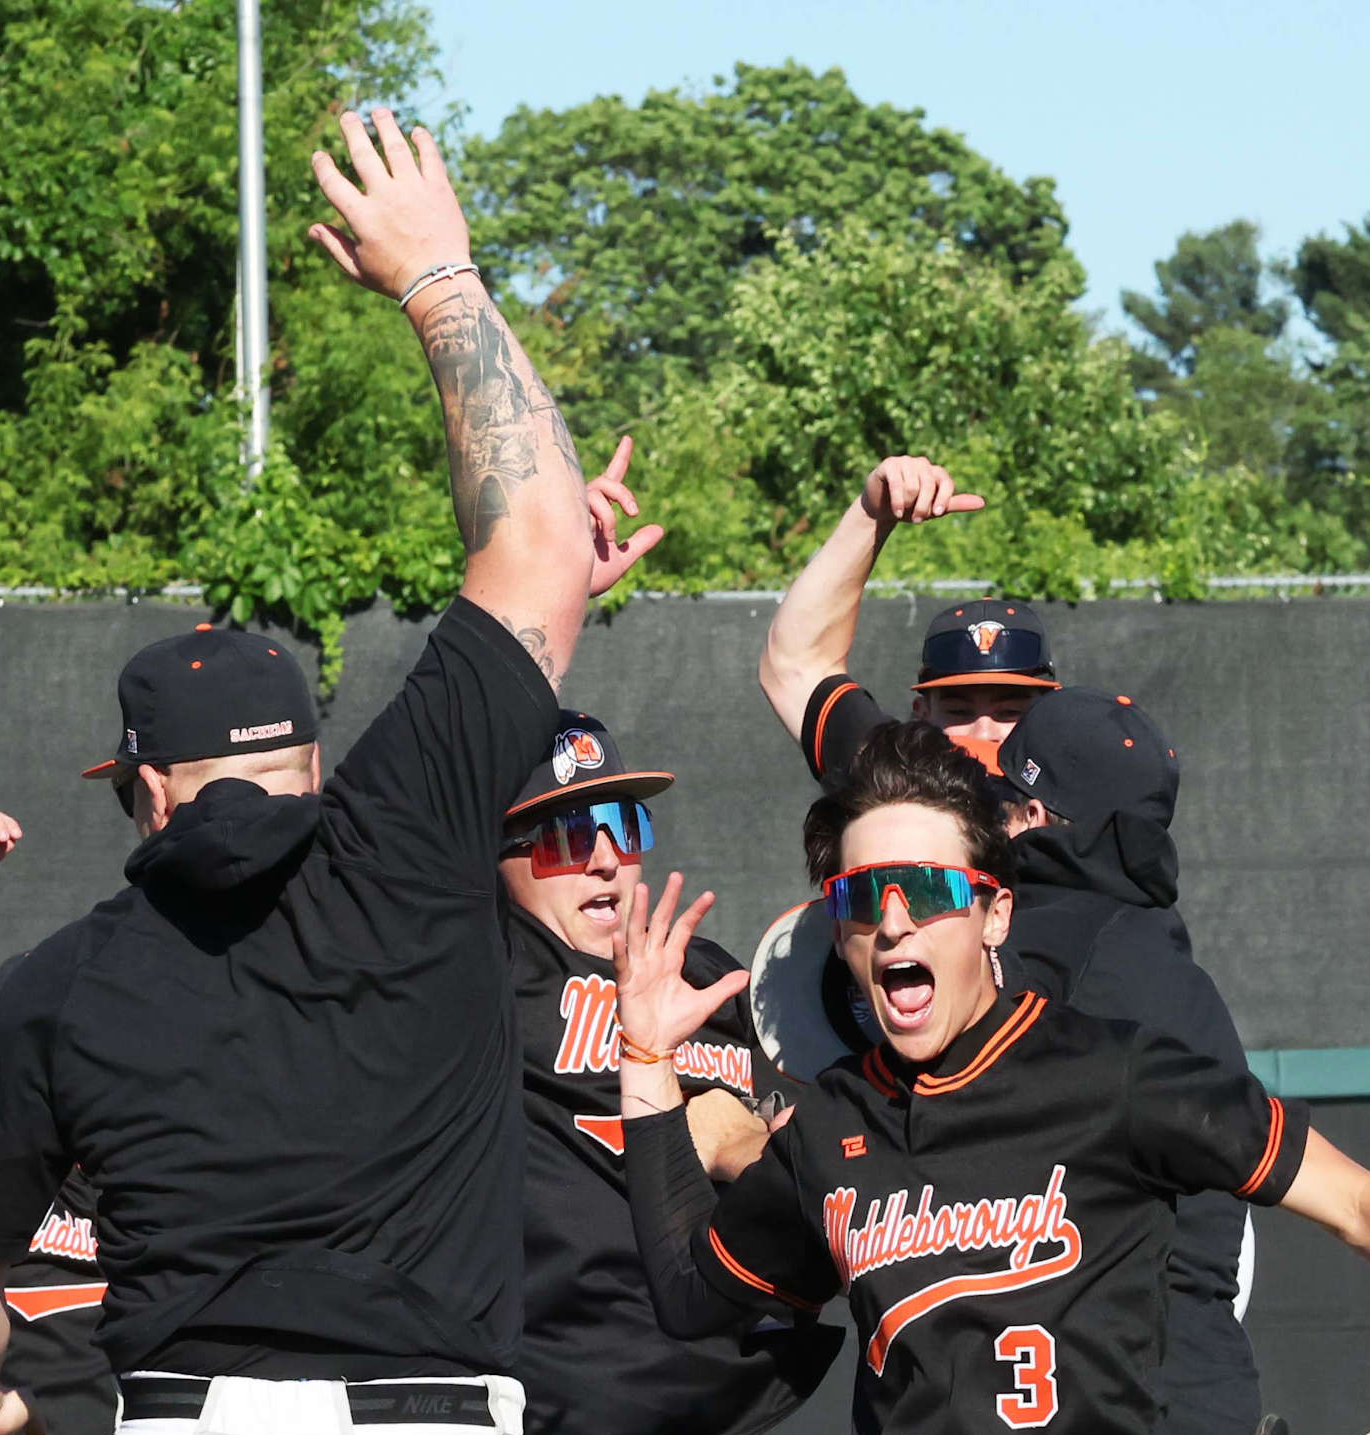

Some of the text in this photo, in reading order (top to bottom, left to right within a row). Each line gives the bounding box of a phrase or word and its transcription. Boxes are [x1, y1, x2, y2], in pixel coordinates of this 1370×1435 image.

[823, 1164, 1069, 1292] Middleborough
[403, 1394, 456, 1415] NIKE
[993, 1323, 1059, 1430] 3
